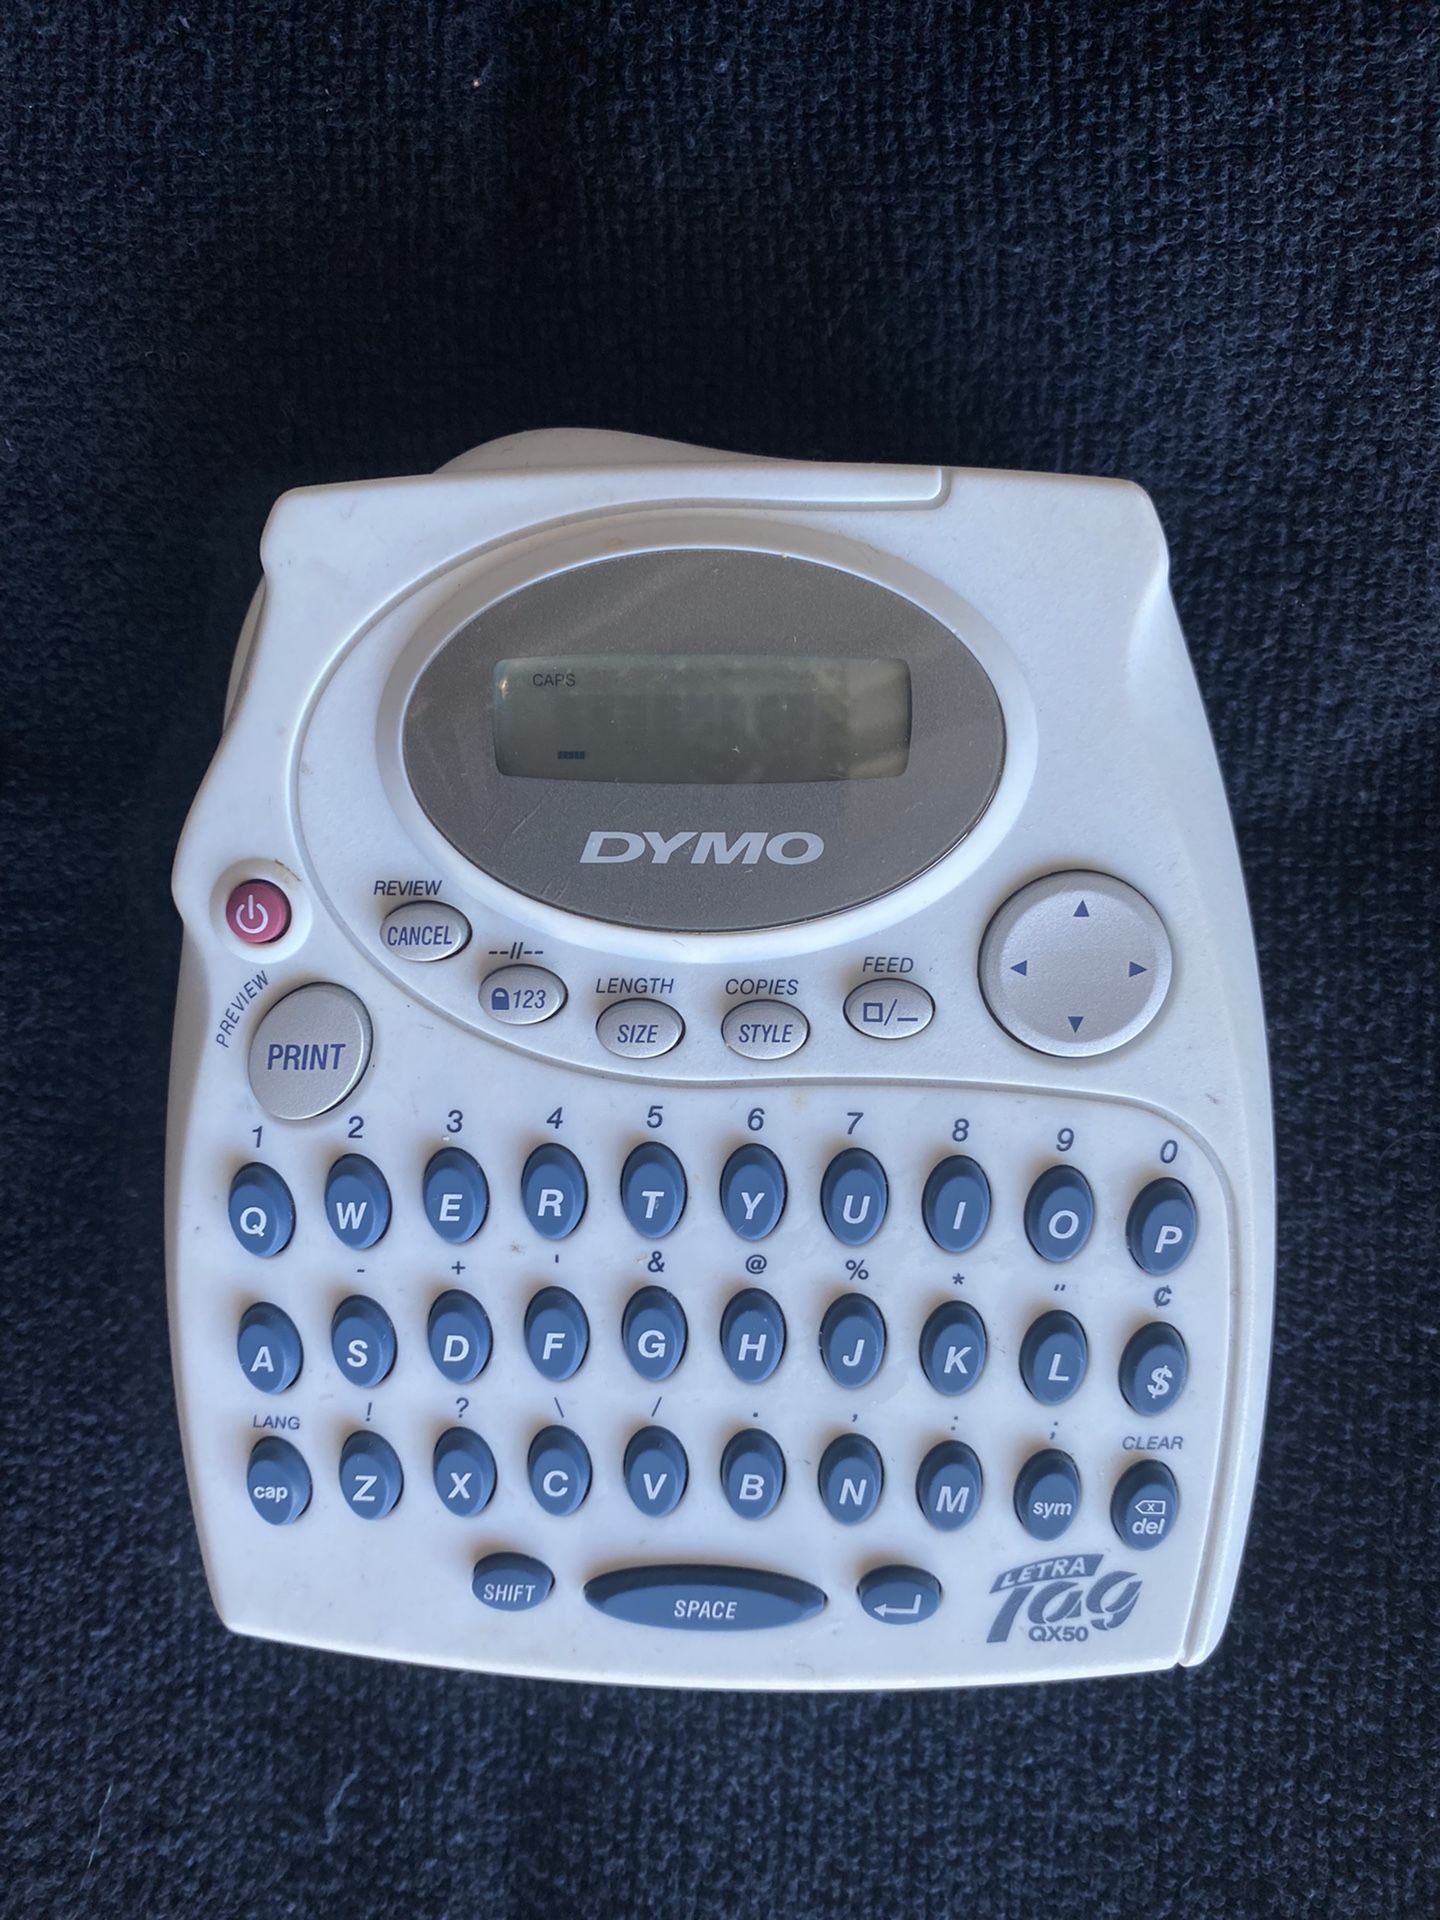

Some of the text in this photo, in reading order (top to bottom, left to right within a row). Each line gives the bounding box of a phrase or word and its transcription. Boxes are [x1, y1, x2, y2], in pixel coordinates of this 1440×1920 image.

[532, 673, 576, 687] CAPS
[579, 831, 825, 865] DYMO
[373, 880, 443, 896] REVIEW
[386, 925, 453, 947] CANCEL
[861, 956, 914, 973] FEED
[595, 978, 674, 994] LENGTH
[725, 978, 800, 996] COPIES
[215, 969, 270, 1049] PREVIEW
[512, 989, 546, 1009] 123
[616, 1024, 659, 1044] SIZE
[738, 1024, 794, 1044] STYLE
[266, 1043, 346, 1071] PRINT
[347, 1116, 365, 1139] 2
[446, 1110, 464, 1133] 3
[546, 1107, 564, 1129] 4
[646, 1105, 664, 1128] 5
[747, 1107, 765, 1131] 6
[846, 1112, 864, 1135] 7
[252, 1125, 263, 1148] 1
[951, 1118, 970, 1142] 8
[1055, 1127, 1074, 1152] 9
[1159, 1139, 1178, 1164] 0
[439, 1194, 463, 1222] E
[537, 1188, 564, 1217] R
[641, 1190, 665, 1219] T
[740, 1192, 765, 1220] Y
[842, 1194, 871, 1225] U
[239, 1206, 267, 1237] Q
[335, 1201, 367, 1230] W
[953, 1201, 966, 1230] I
[1048, 1210, 1079, 1240] O
[1154, 1225, 1183, 1254] P
[647, 1250, 665, 1273] &
[745, 1254, 768, 1275] @
[845, 1259, 870, 1281] %
[1153, 1284, 1172, 1308] ¢
[346, 1339, 368, 1368] S
[443, 1335, 470, 1362] D
[542, 1332, 565, 1360] F
[637, 1330, 666, 1358] G
[737, 1334, 767, 1361] H
[842, 1339, 865, 1367] J
[250, 1346, 275, 1373] A
[943, 1346, 972, 1375] K
[1048, 1353, 1070, 1382] L
[1146, 1364, 1174, 1399] $
[365, 1402, 373, 1422] !
[455, 1397, 469, 1418] ?
[252, 1414, 301, 1431] LANG
[1121, 1435, 1184, 1451] CLEAR
[253, 1485, 289, 1503] cap
[352, 1475, 378, 1502] Z
[448, 1472, 472, 1499] X
[542, 1470, 570, 1498] C
[642, 1473, 668, 1501] V
[738, 1474, 765, 1501] B
[838, 1478, 867, 1506] N
[935, 1486, 970, 1514] M
[1032, 1501, 1073, 1522] sym
[1132, 1518, 1166, 1536] del
[999, 1556, 1086, 1589] LETRA
[483, 1583, 536, 1602] SHIFT
[673, 1599, 737, 1620] SPACE
[986, 1570, 1144, 1644] Tag
[1028, 1626, 1089, 1642] QX50
